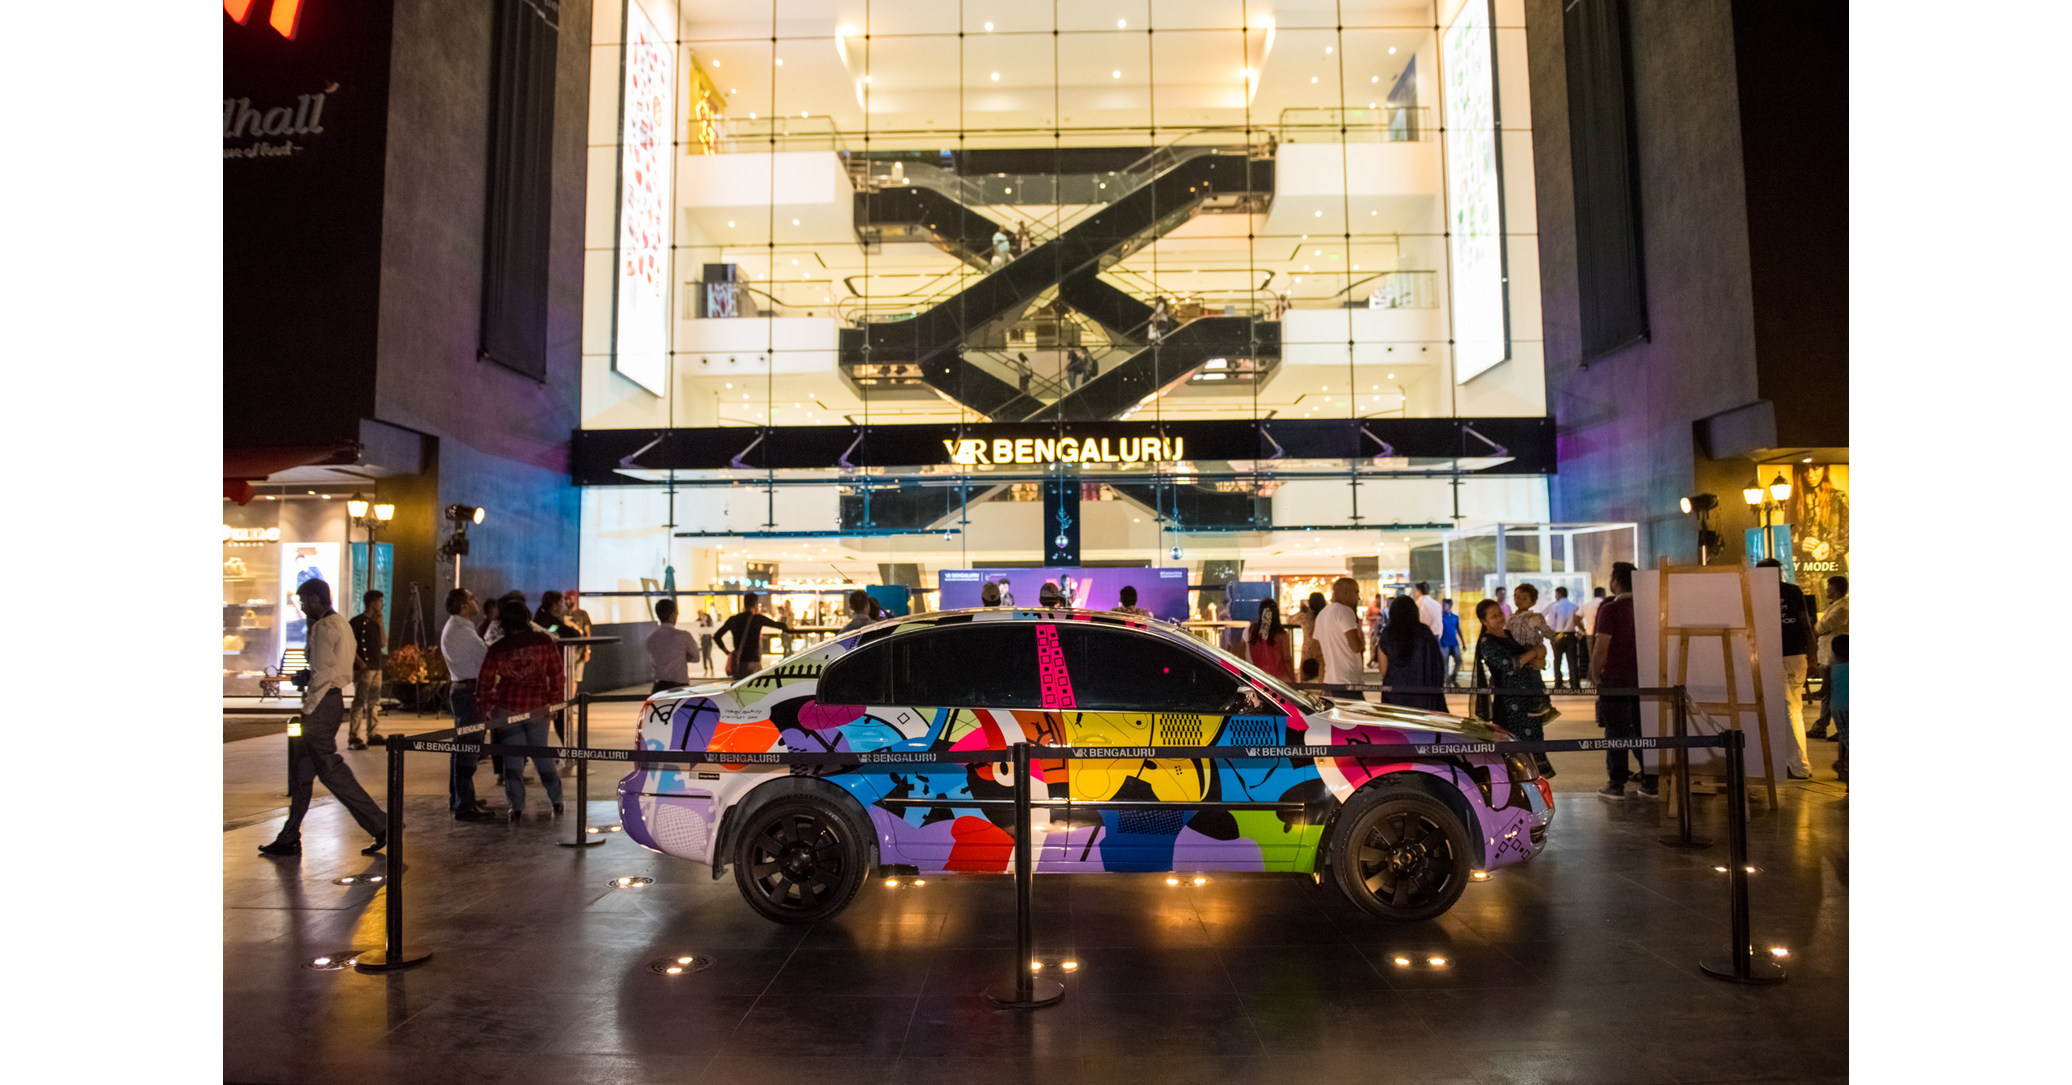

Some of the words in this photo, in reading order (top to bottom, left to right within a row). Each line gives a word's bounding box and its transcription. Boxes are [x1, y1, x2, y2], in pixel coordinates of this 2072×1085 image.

[992, 437, 1184, 463] BENGALURU
[1803, 561, 1839, 571] MODE:
[427, 742, 480, 752] BENGALURU
[1431, 743, 1496, 754] BENGALURU
[1595, 739, 1656, 748] BENGALURU
[571, 749, 629, 760] BENGALURU
[1089, 748, 1156, 757] BENGALURU
[1262, 746, 1328, 756] BENGALURU
[720, 754, 780, 763] BENGALURU
[873, 753, 937, 763] BENGALURU
